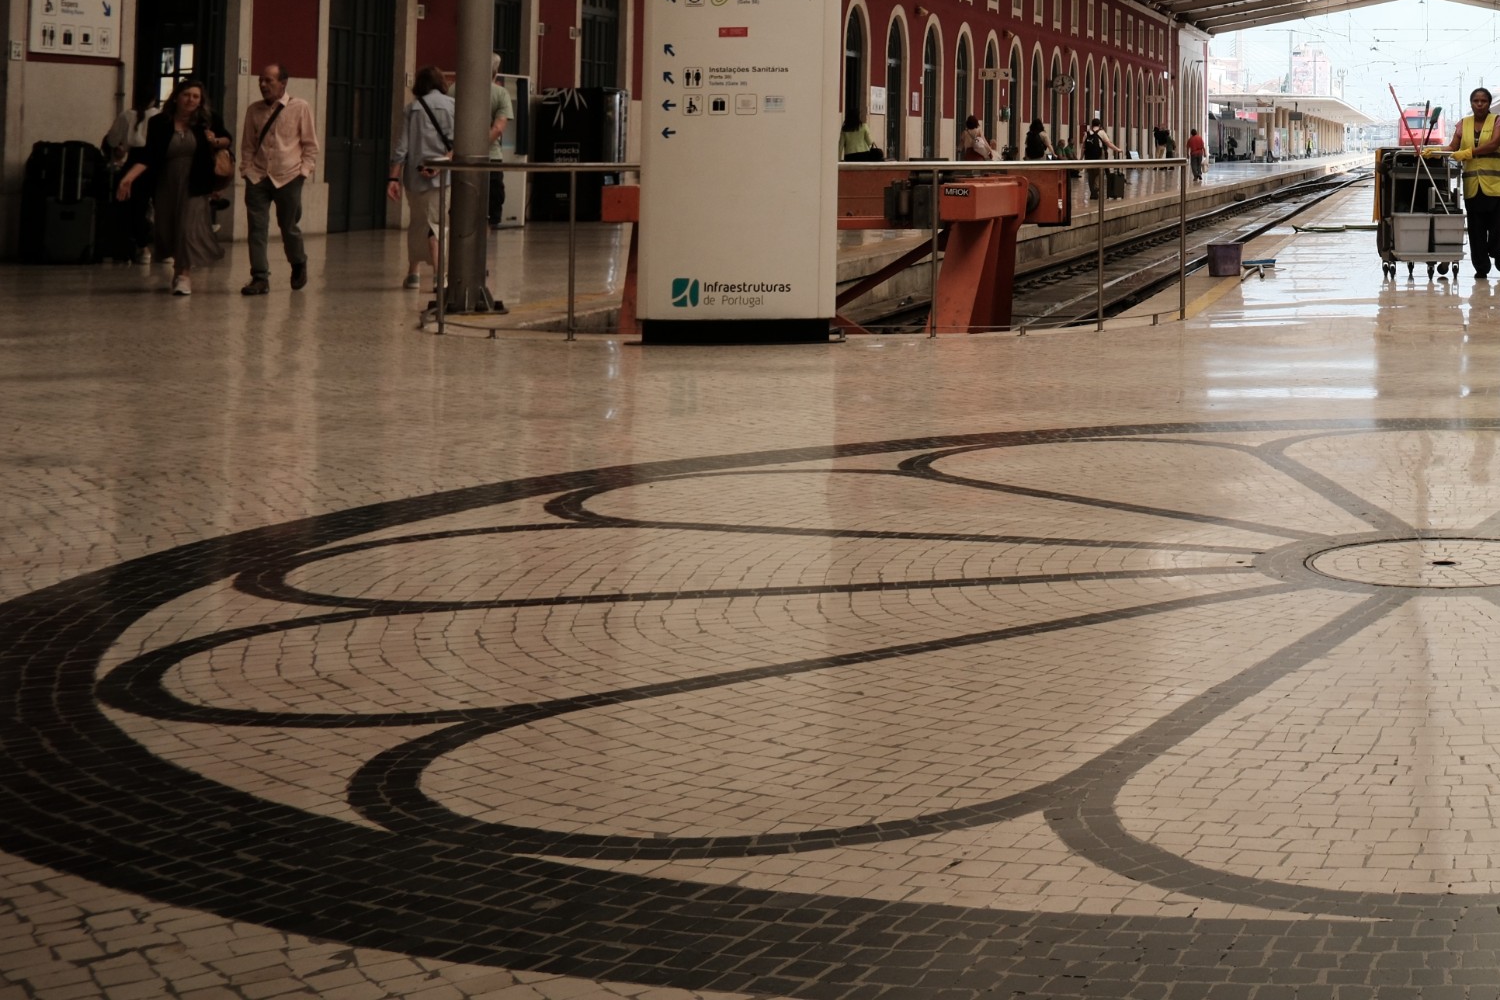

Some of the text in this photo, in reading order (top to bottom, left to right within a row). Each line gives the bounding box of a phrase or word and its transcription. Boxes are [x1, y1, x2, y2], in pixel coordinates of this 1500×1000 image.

[709, 66, 749, 74] Instalações
[704, 282, 791, 293] Infraestruturas
[703, 295, 764, 308] de Portugal
